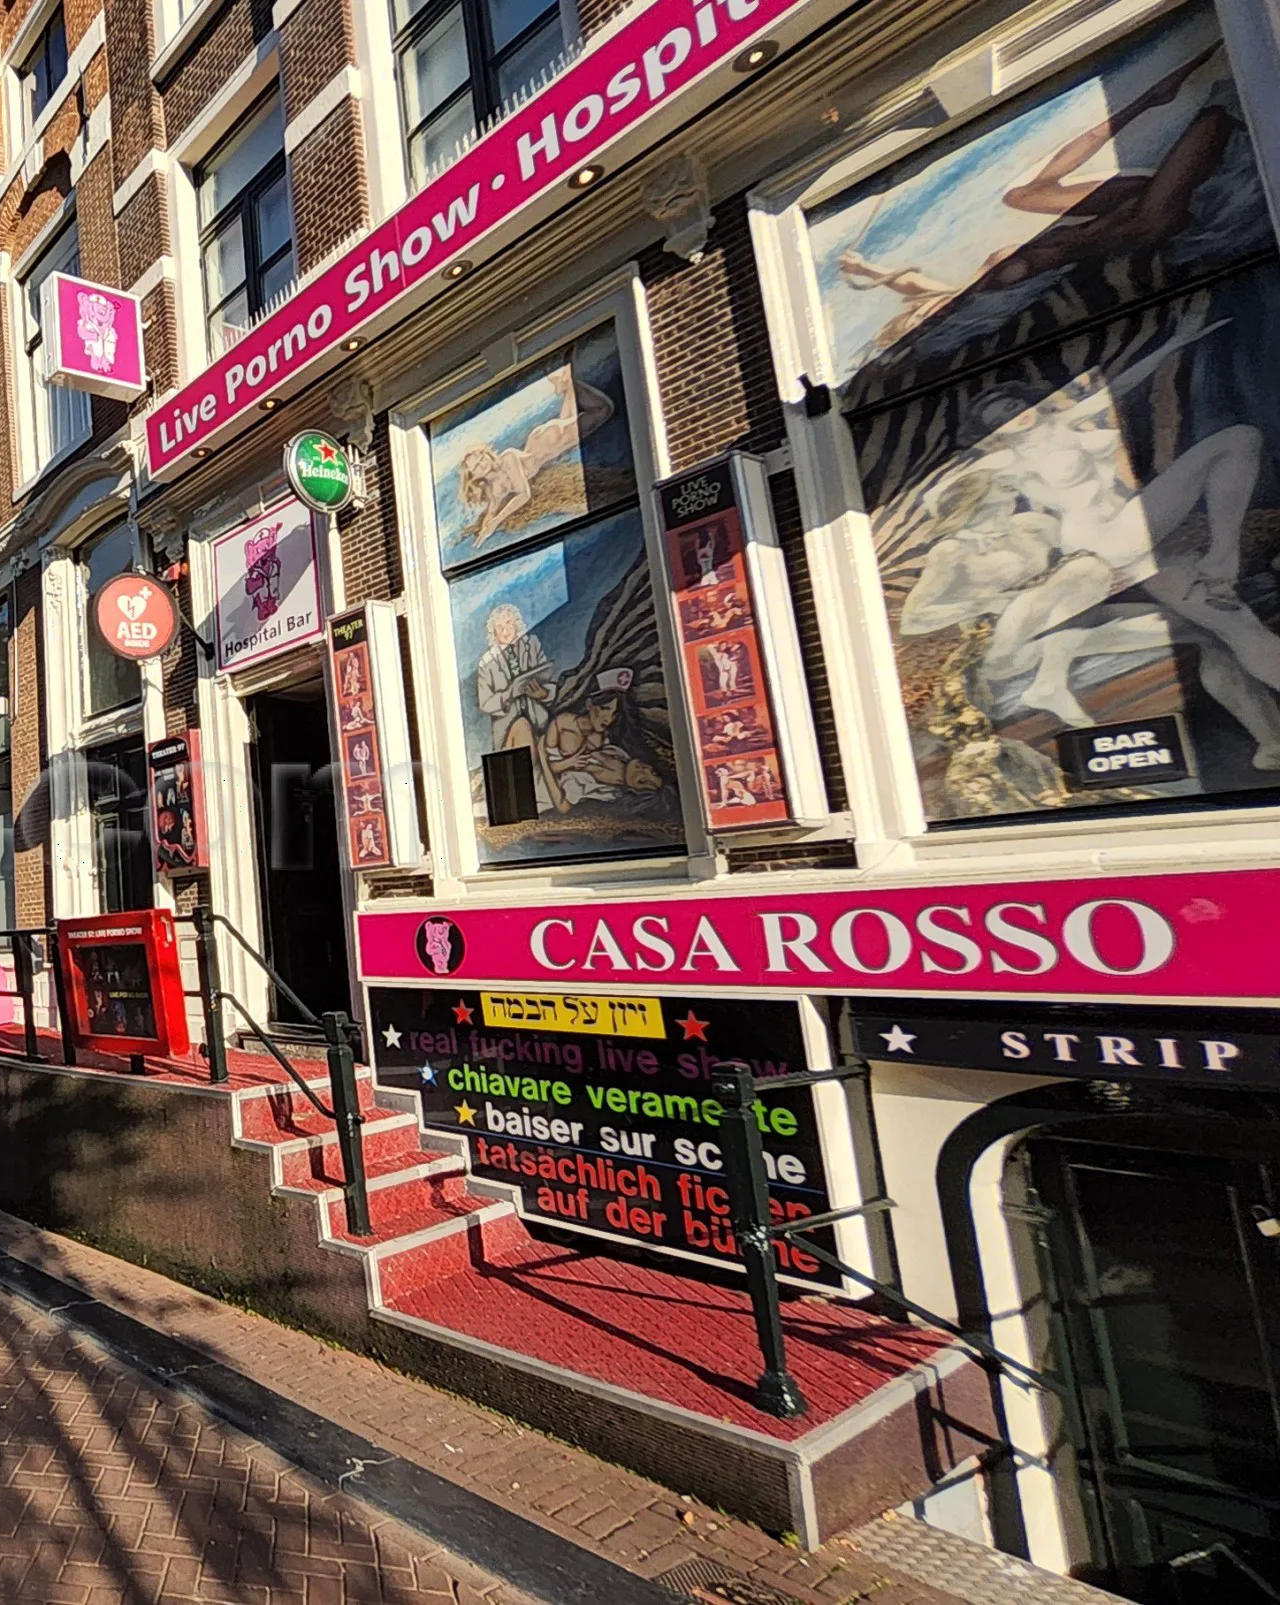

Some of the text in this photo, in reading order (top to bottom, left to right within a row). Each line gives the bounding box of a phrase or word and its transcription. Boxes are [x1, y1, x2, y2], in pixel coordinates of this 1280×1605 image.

[159, 393, 217, 454] Live
[225, 304, 333, 405] Porno
[344, 182, 481, 314] Show
[671, 482, 722, 510] PORNO
[680, 475, 709, 495] LIVE
[676, 493, 718, 518] SHOW
[116, 621, 158, 640] AED
[225, 611, 312, 658] Hospital Bar
[333, 619, 363, 637] THEATER
[151, 746, 178, 760] THEATER
[1087, 748, 1173, 774] OPEN
[1092, 730, 1157, 753] BAR
[528, 898, 1174, 976] CASA ROSSO
[490, 996, 648, 1033] זיון על הבמה
[408, 1027, 788, 1080] real fucking live shw
[1000, 1030, 1242, 1072] STRIP
[448, 1063, 799, 1136] chiavare veramete
[485, 1101, 807, 1184] baiser sur scne
[477, 1136, 815, 1233] tatsächlich ficen
[537, 1186, 820, 1274] auf der büne
